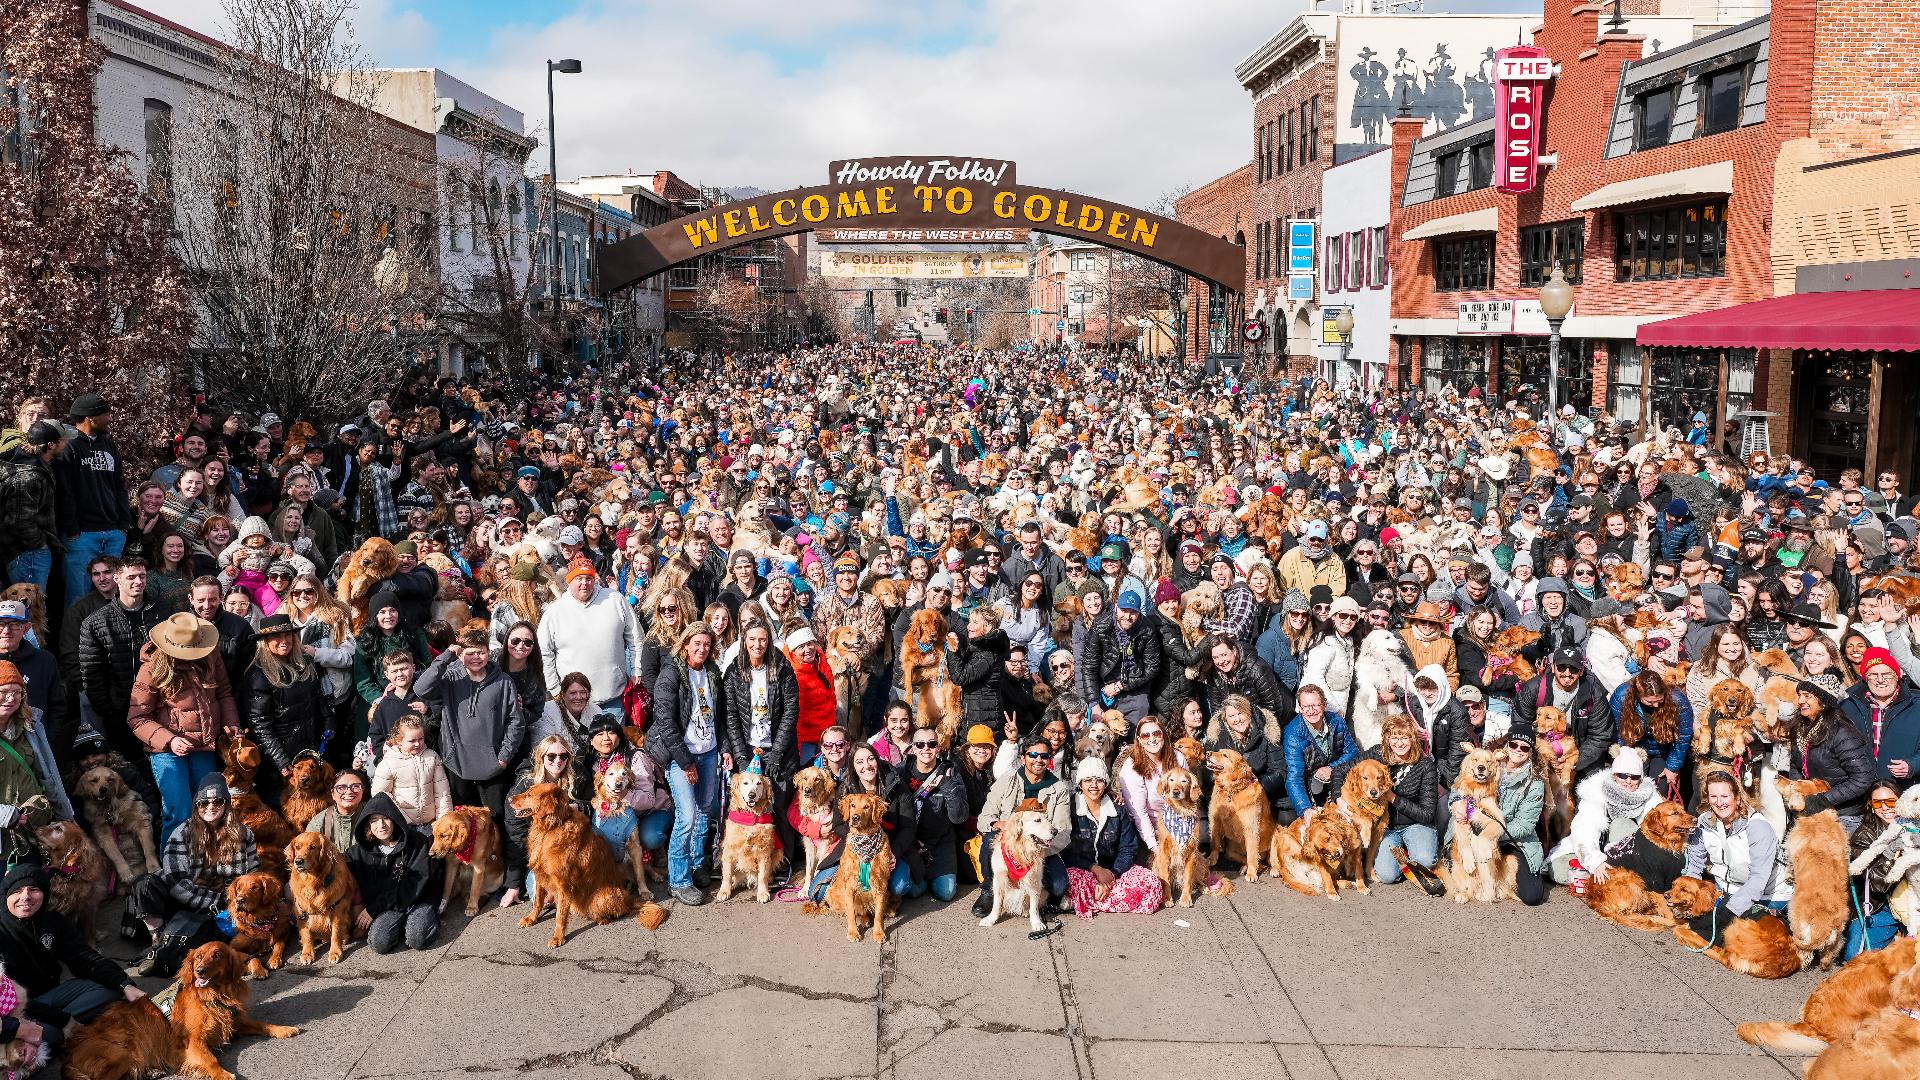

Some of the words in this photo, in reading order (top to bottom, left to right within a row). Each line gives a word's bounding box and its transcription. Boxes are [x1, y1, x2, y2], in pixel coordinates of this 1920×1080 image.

[1503, 62, 1548, 75] THE
[1509, 86, 1532, 183] ROSE
[837, 160, 925, 185] Howdy
[927, 160, 1008, 187] Folks!
[682, 186, 898, 249] WELCOME
[913, 185, 974, 215] TO
[993, 191, 1160, 248] GOLDEN
[833, 230, 889, 240] WHERE
[893, 230, 923, 240] THE
[925, 230, 969, 240] WEST
[971, 230, 1014, 240] LIVES
[851, 254, 914, 265] GOLDENS
[852, 265, 862, 275] IN
[865, 265, 914, 275] GOLDEN
